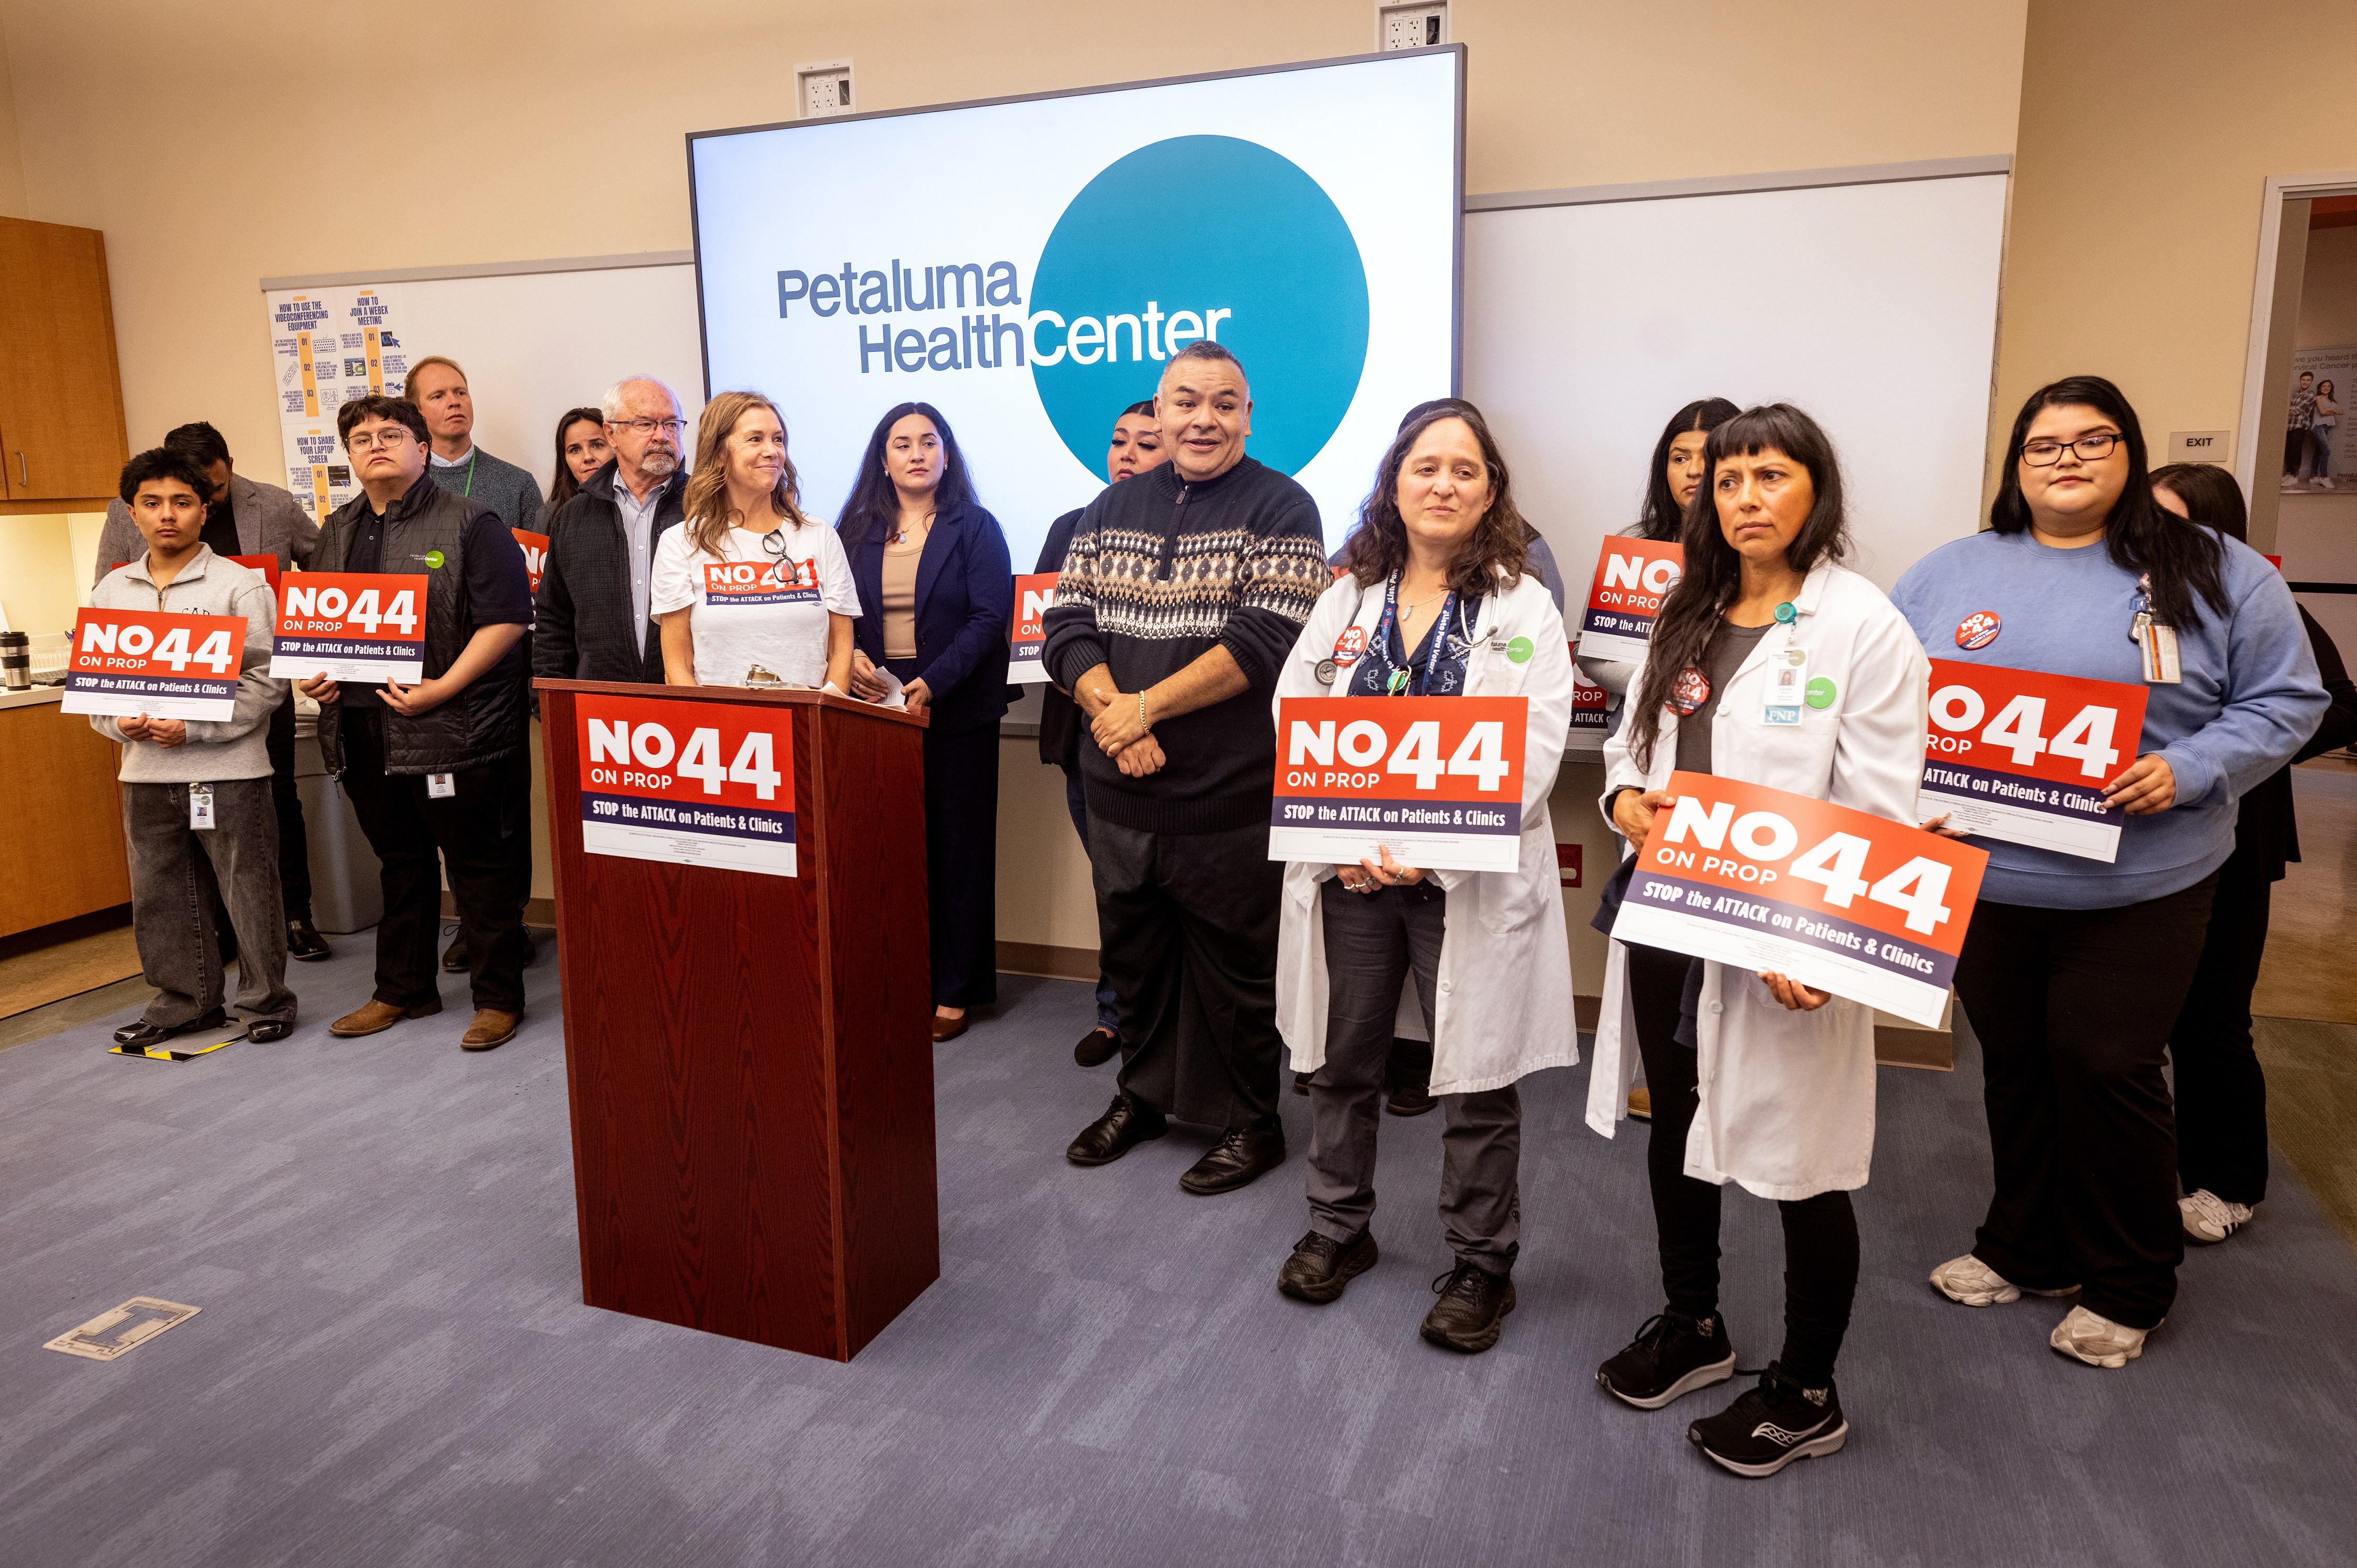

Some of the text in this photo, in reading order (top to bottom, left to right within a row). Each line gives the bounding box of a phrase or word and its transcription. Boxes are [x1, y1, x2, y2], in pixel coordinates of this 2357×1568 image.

[777, 258, 1021, 318] Petaluma
[279, 303, 291, 312] HOW
[301, 302, 310, 311] USE
[312, 301, 322, 310] THE
[357, 296, 378, 306] HOW TO
[275, 311, 328, 322] VIDEOCONFERENCING
[350, 306, 388, 316] JOIN A WEBEX
[288, 321, 317, 331] EQUIPMENT
[358, 316, 382, 326] MEETING
[297, 437, 309, 446] HOW
[2187, 438, 2213, 447] EXIT
[315, 446, 334, 454] LAPTOP
[308, 455, 328, 463] SCREEN
[710, 566, 755, 583] NO
[1603, 553, 1681, 594] NO
[1022, 588, 1054, 621] N
[1600, 591, 1659, 609] ON PRO
[285, 587, 417, 634] NO 44
[284, 620, 343, 632] ON PROP
[1021, 624, 1041, 635] ON
[1594, 615, 1617, 628] STOP
[1619, 619, 1633, 631] the
[1961, 614, 1984, 631] NO
[1971, 616, 1995, 634] 44
[1343, 630, 1361, 639] NO
[1435, 631, 1445, 648] Para
[82, 623, 233, 673] NO 44
[281, 642, 301, 651] STOP
[303, 643, 314, 652] the
[316, 643, 342, 653] ATTACK
[355, 645, 384, 655] Patients
[386, 646, 391, 655] &
[393, 646, 415, 656] Clinics
[1019, 646, 1040, 656] STOP
[1344, 639, 1362, 650] 44
[80, 656, 147, 668] ON PROP
[75, 677, 98, 687] STOP
[101, 679, 114, 688] the
[116, 680, 146, 690] ATTACK
[159, 682, 192, 692] Patients
[194, 684, 200, 693] &
[202, 684, 227, 694] Clinics
[1679, 684, 1702, 700] 44
[1573, 691, 1603, 701] ROP
[1575, 713, 1604, 723] ATTACK
[1768, 711, 1796, 721] FNP
[1928, 682, 2119, 778] O 44
[1925, 734, 1973, 754] ROP
[588, 719, 780, 800] NO 44
[1288, 720, 1508, 791] NO 44
[591, 769, 671, 789] ON PROP
[1287, 772, 1380, 788] ON PROP
[1923, 768, 1970, 788] ATTACK
[1973, 779, 1989, 792] on
[1991, 780, 2046, 802] Patients
[2049, 791, 2059, 805] &
[593, 800, 783, 834] STOP the ATTACK on Patients & Clinics
[1284, 804, 1505, 826] STOP the ATTACK on Patients & Clinics
[1657, 848, 1777, 885] ON PROP
[1664, 796, 1952, 935] NO 44
[1643, 882, 1934, 974] STOP the ATTACK on Patients & Clinics
